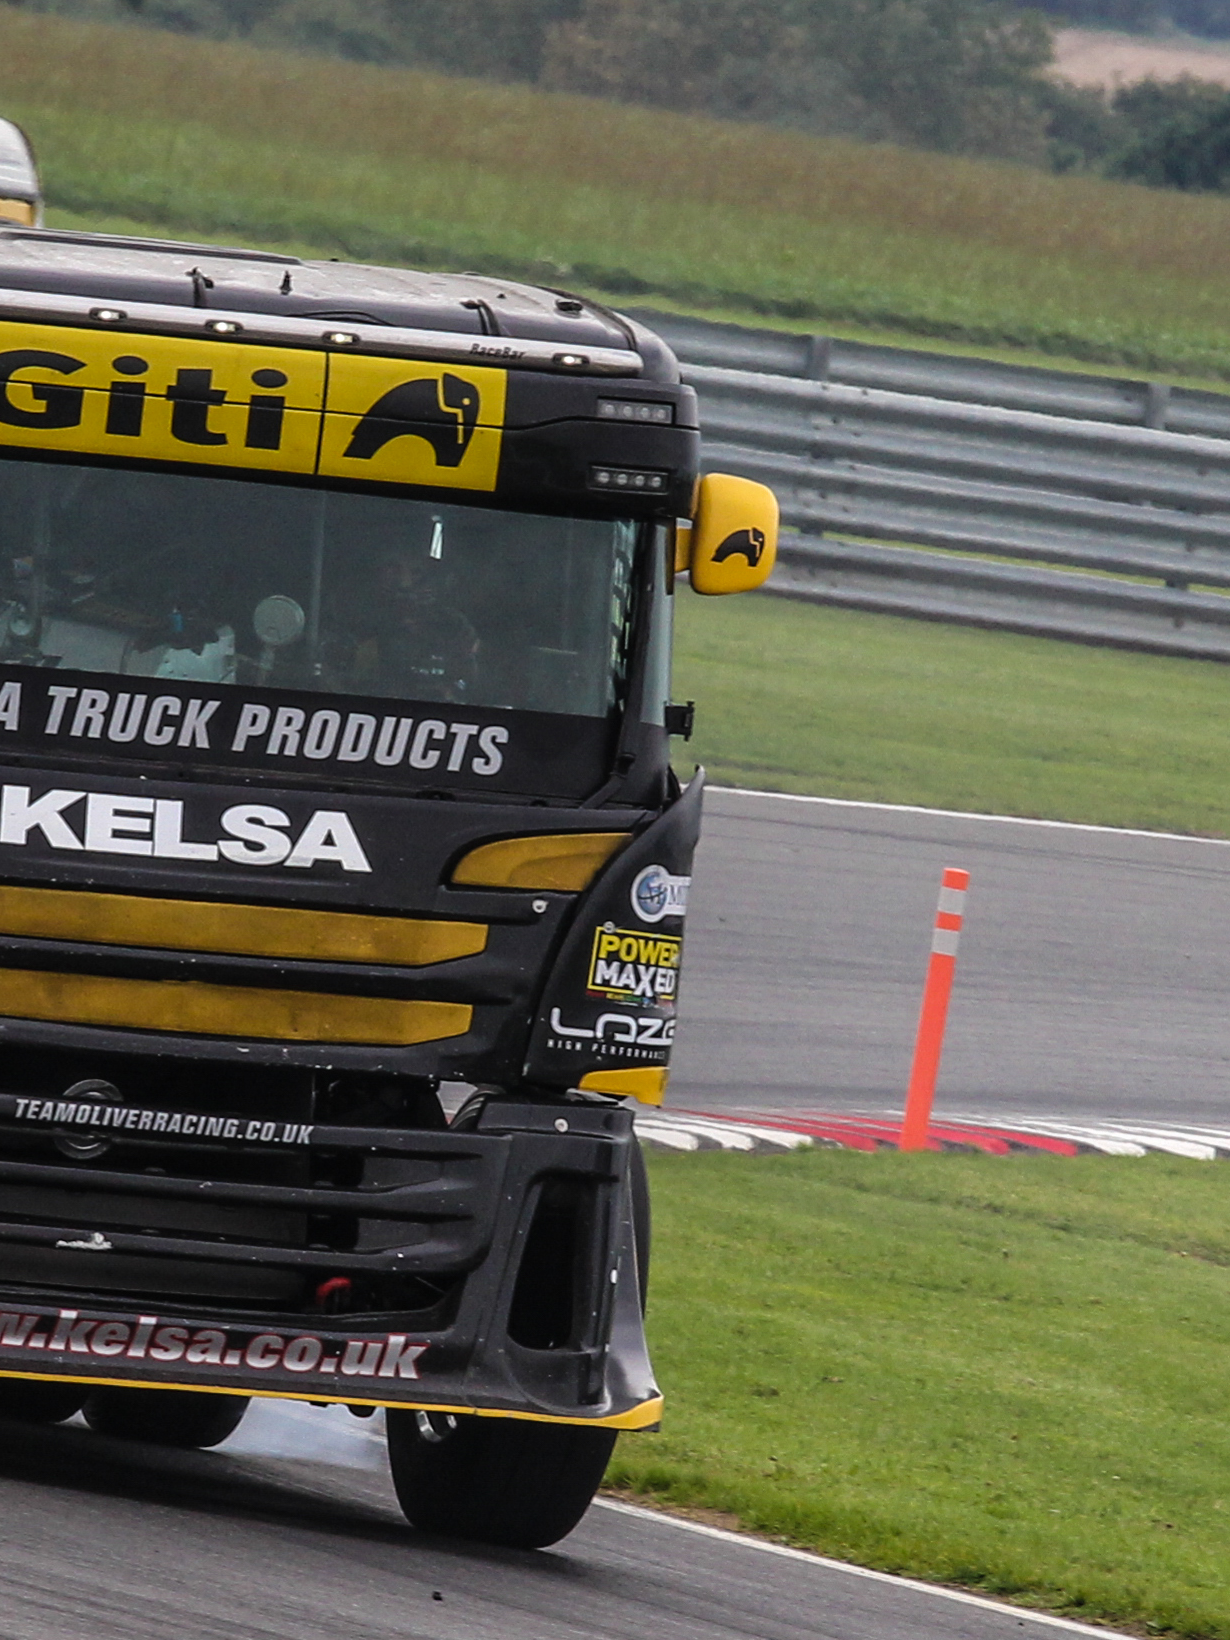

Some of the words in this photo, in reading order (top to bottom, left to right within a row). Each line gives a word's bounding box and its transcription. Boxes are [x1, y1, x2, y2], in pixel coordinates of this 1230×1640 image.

[470, 343, 526, 358] RaceBar
[44, 686, 221, 749] TRUCK
[230, 703, 510, 777] PRODUCTS
[598, 934, 679, 967] POWER
[594, 959, 676, 997] MAXED
[551, 1007, 676, 1045] LAZ
[591, 1043, 665, 1059] PERFORMAN
[15, 1098, 314, 1145] TEAMOLIVERRACING.CO.UK
